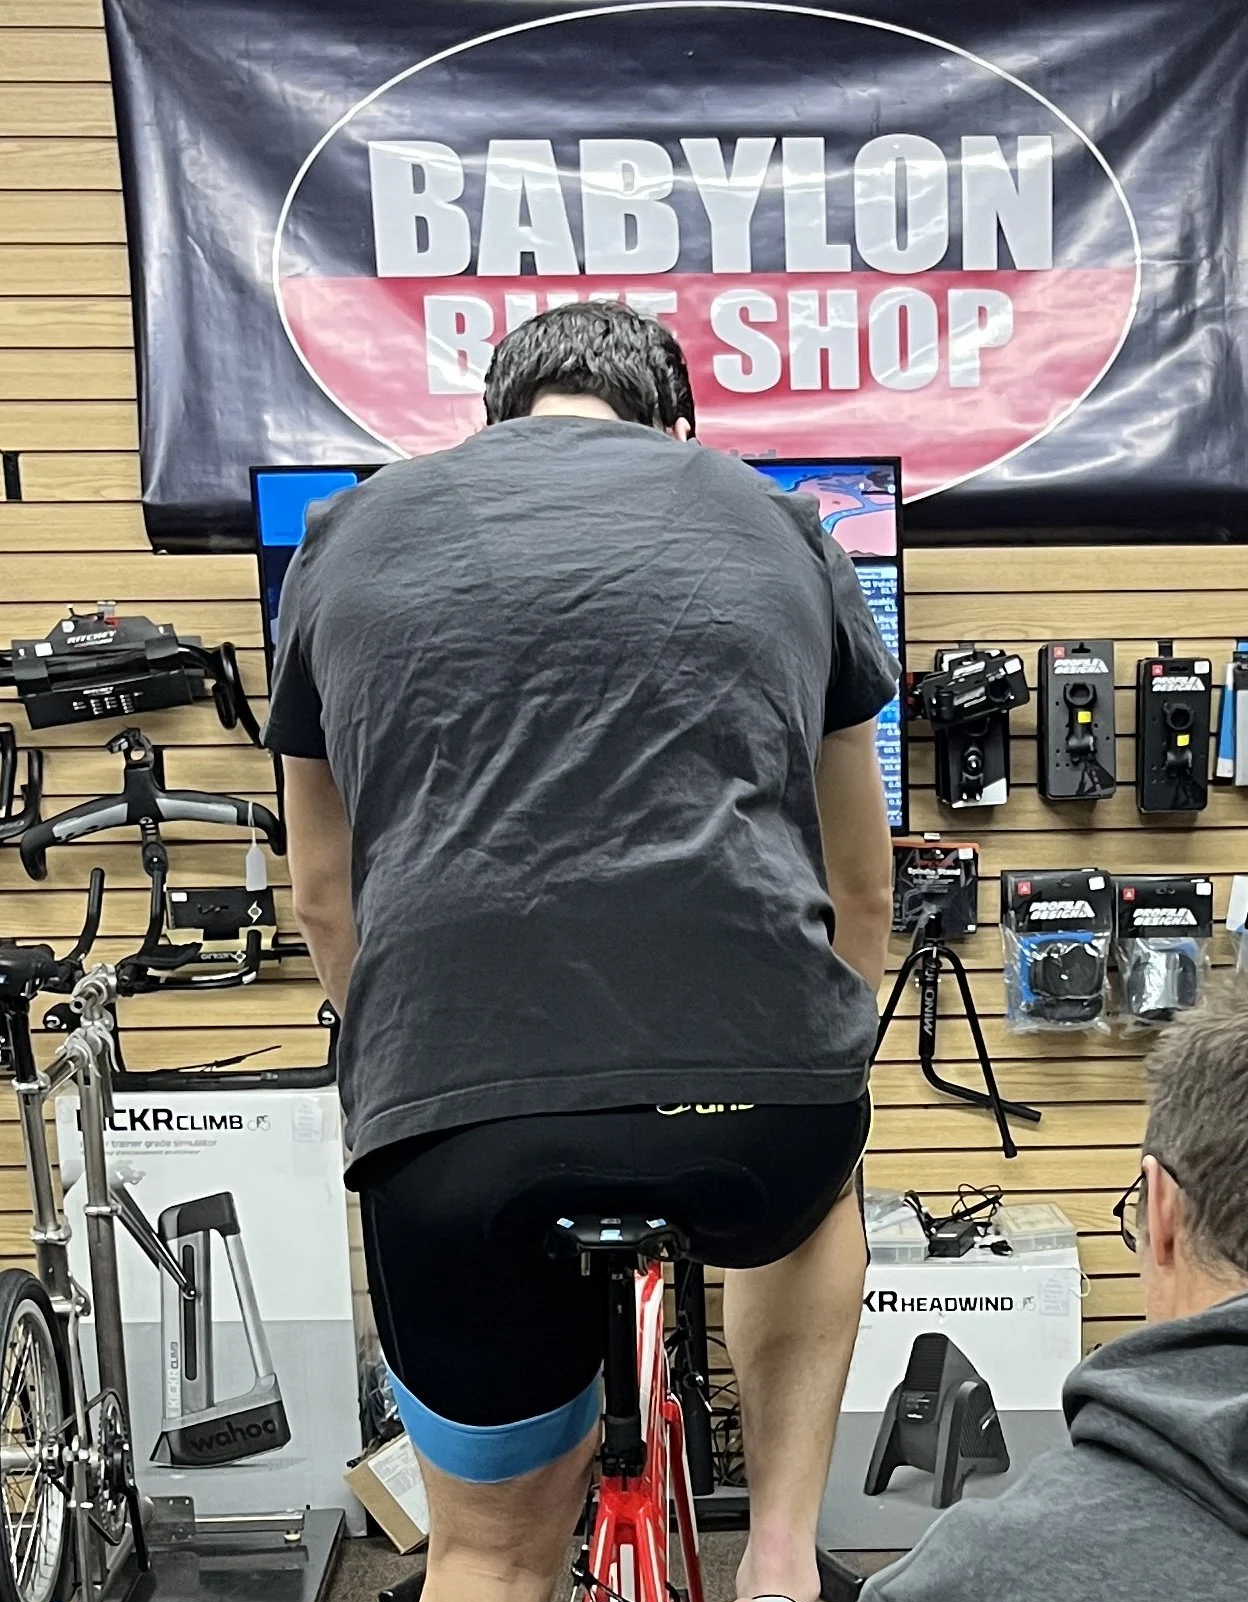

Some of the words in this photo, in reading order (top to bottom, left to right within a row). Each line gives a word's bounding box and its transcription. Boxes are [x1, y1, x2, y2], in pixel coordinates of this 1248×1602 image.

[367, 133, 1055, 278] BABYLON
[709, 286, 1016, 395] SHOP
[66, 630, 117, 645] RITCHEY
[1029, 900, 1082, 912] PROFILE
[1133, 908, 1185, 919] PROFILE
[1029, 909, 1083, 920] DESIGN
[1133, 916, 1183, 926] DESIGN
[75, 1107, 175, 1132] CKR
[176, 1115, 244, 1131] CLIMB
[900, 1296, 1014, 1312] HEADWIND
[190, 1418, 279, 1453] wahoo
